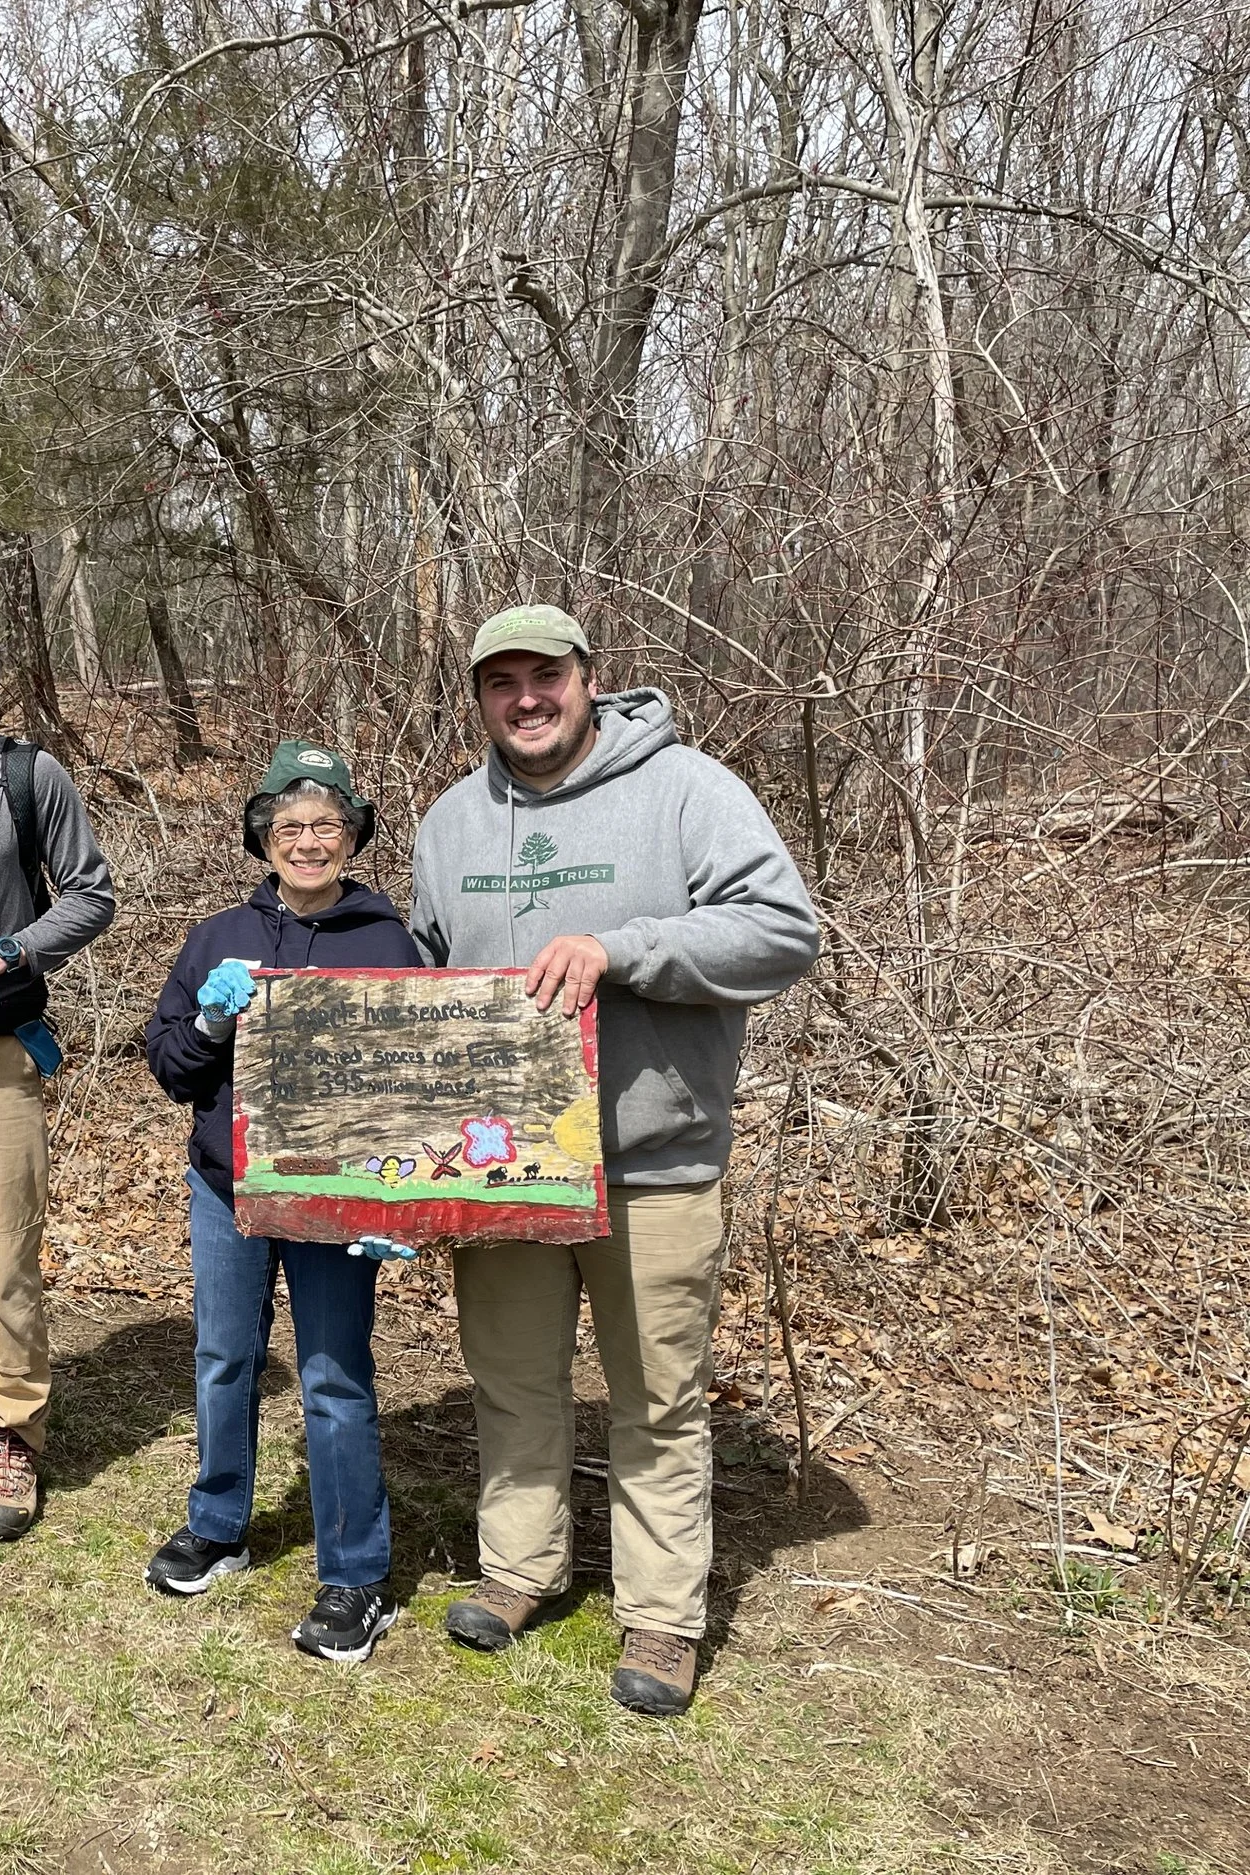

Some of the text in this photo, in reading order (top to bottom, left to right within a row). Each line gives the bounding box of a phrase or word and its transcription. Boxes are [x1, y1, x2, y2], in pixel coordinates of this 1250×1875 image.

[465, 868, 609, 890] WILDLANDS TRUST
[407, 1000, 493, 1023] searched
[304, 1045, 363, 1067] sacred
[465, 1041, 519, 1068] Earth
[316, 1068, 366, 1098] 395
